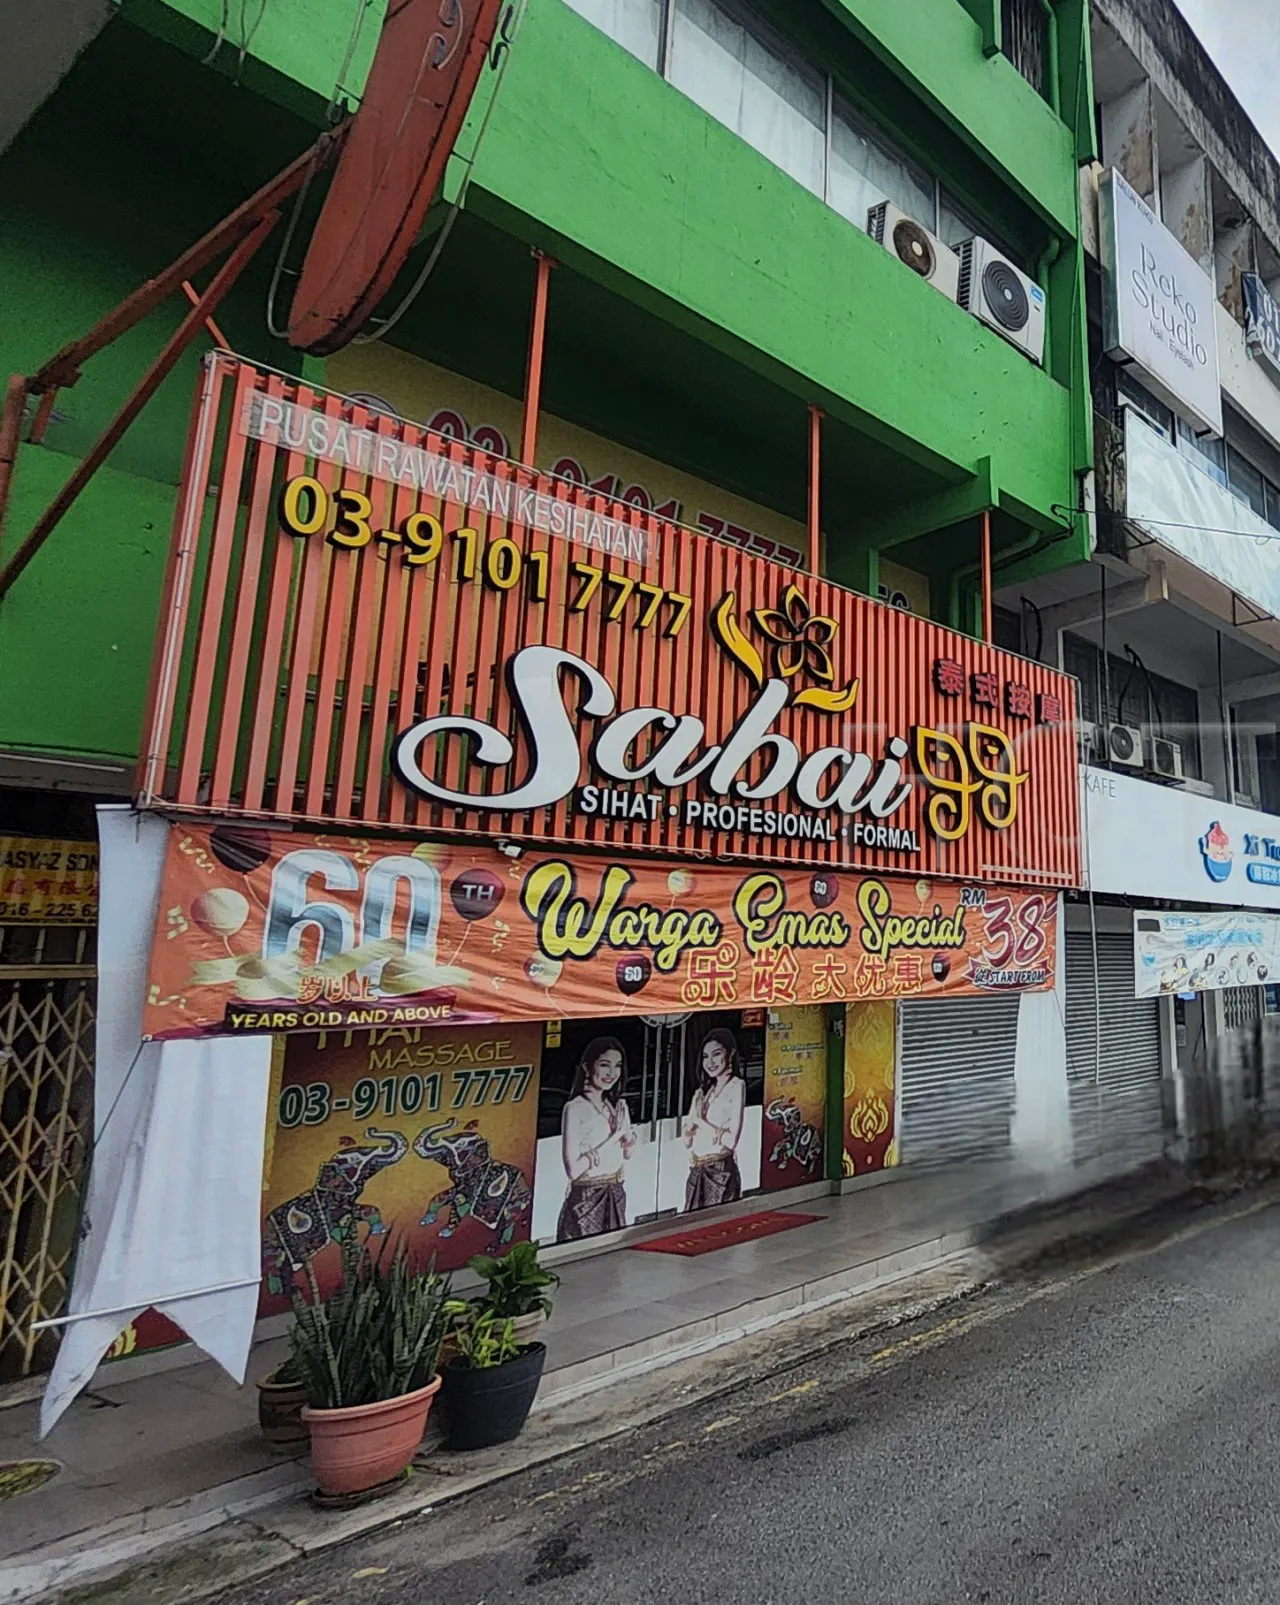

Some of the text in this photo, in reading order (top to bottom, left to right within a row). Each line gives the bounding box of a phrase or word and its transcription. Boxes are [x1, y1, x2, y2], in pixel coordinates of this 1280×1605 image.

[1140, 242, 1197, 324] Reko
[1132, 270, 1207, 366] Studio
[258, 396, 376, 468] PUSAT
[374, 433, 510, 516] RAWATAN
[514, 486, 646, 563] KESIHATAN
[281, 476, 551, 602] 03-9101
[570, 562, 694, 639] 7777
[937, 657, 1062, 726] 泰式按摩
[396, 645, 914, 819] Sabai
[580, 785, 923, 854] SIHAT PROFESIONAL FORMAL
[1084, 774, 1117, 799] KAFE
[262, 848, 442, 992] 60
[461, 882, 495, 901] TH
[521, 859, 967, 973] Warga Emas Special
[960, 887, 987, 906] RM
[982, 894, 1047, 969] 38
[296, 974, 379, 1005] 岁以上
[680, 939, 925, 1007] 乐龄大优惠
[987, 967, 1047, 985] START FROM
[231, 1004, 452, 1029] YEARS OLD AND ABOVE
[368, 1040, 515, 1071] MASSAGE
[277, 1063, 534, 1128] 03-9101 7777
